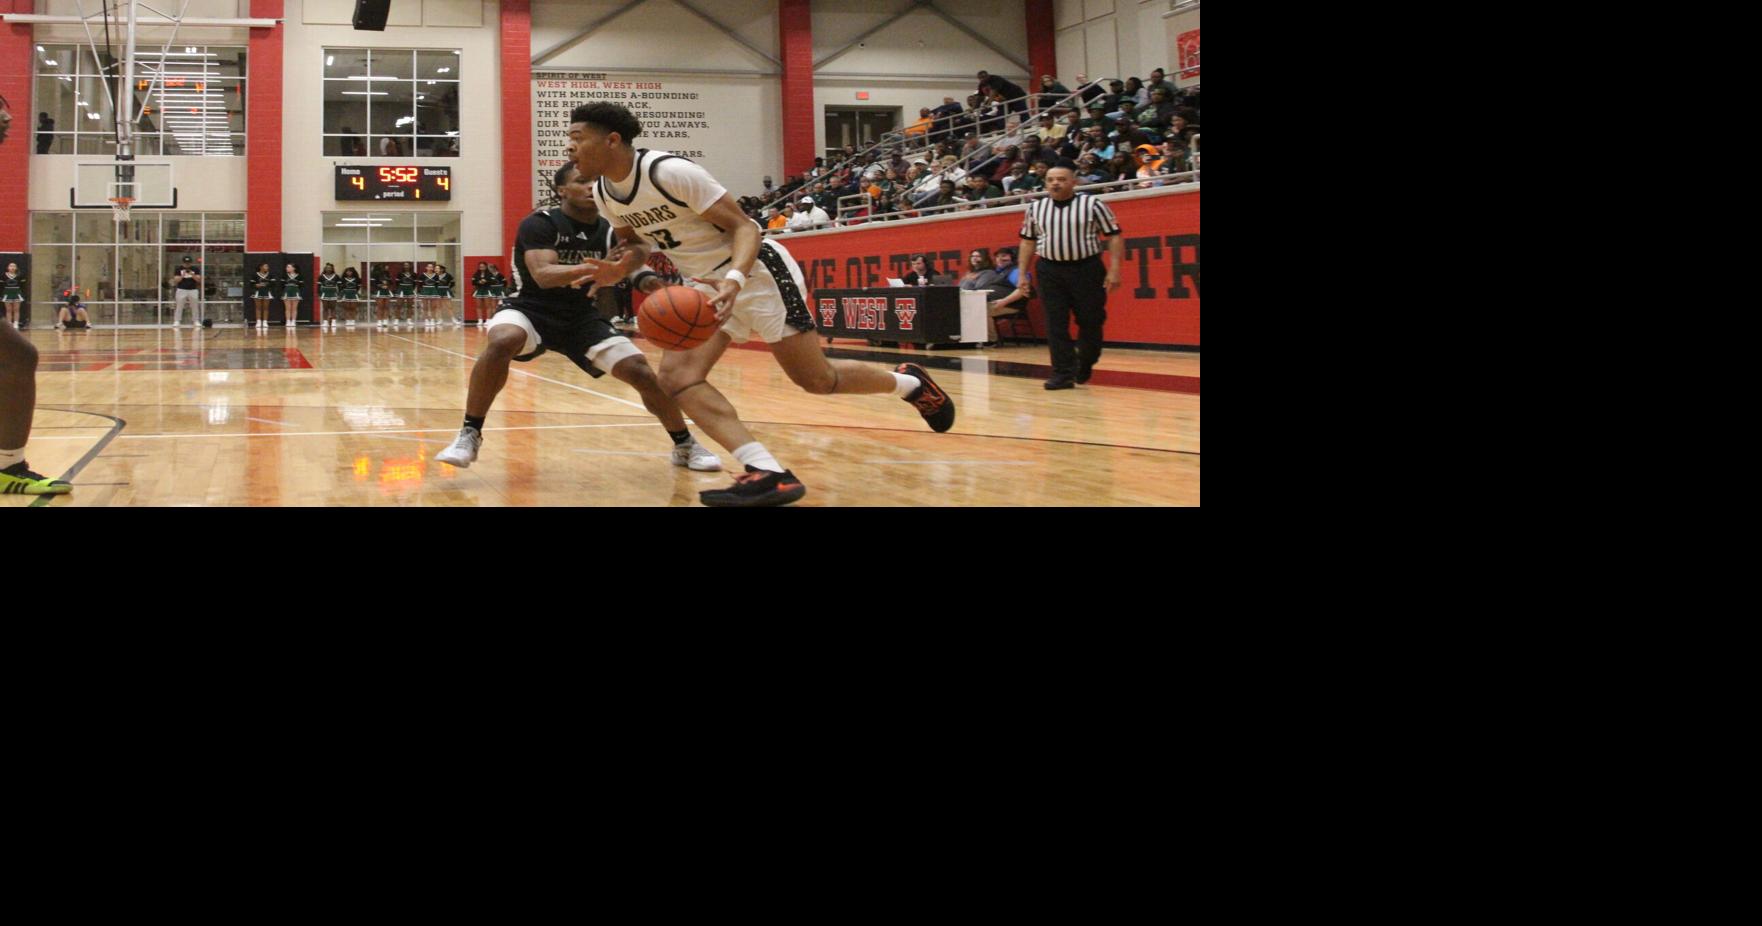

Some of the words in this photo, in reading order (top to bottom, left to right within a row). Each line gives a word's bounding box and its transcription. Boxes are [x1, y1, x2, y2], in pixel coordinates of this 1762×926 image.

[536, 72, 566, 80] SPIRIT
[536, 81, 567, 89] WEST
[603, 82, 633, 90] WEST
[537, 91, 567, 99] WITH
[570, 91, 627, 99] MEMORIES
[630, 92, 699, 100] A-BOUNDING!
[380, 167, 418, 182] 5:52
[352, 177, 364, 190] 4
[437, 177, 449, 191] 4
[415, 188, 420, 199] 1
[846, 254, 881, 289] OF
[889, 250, 962, 283] TE
[842, 296, 887, 331] WEST
